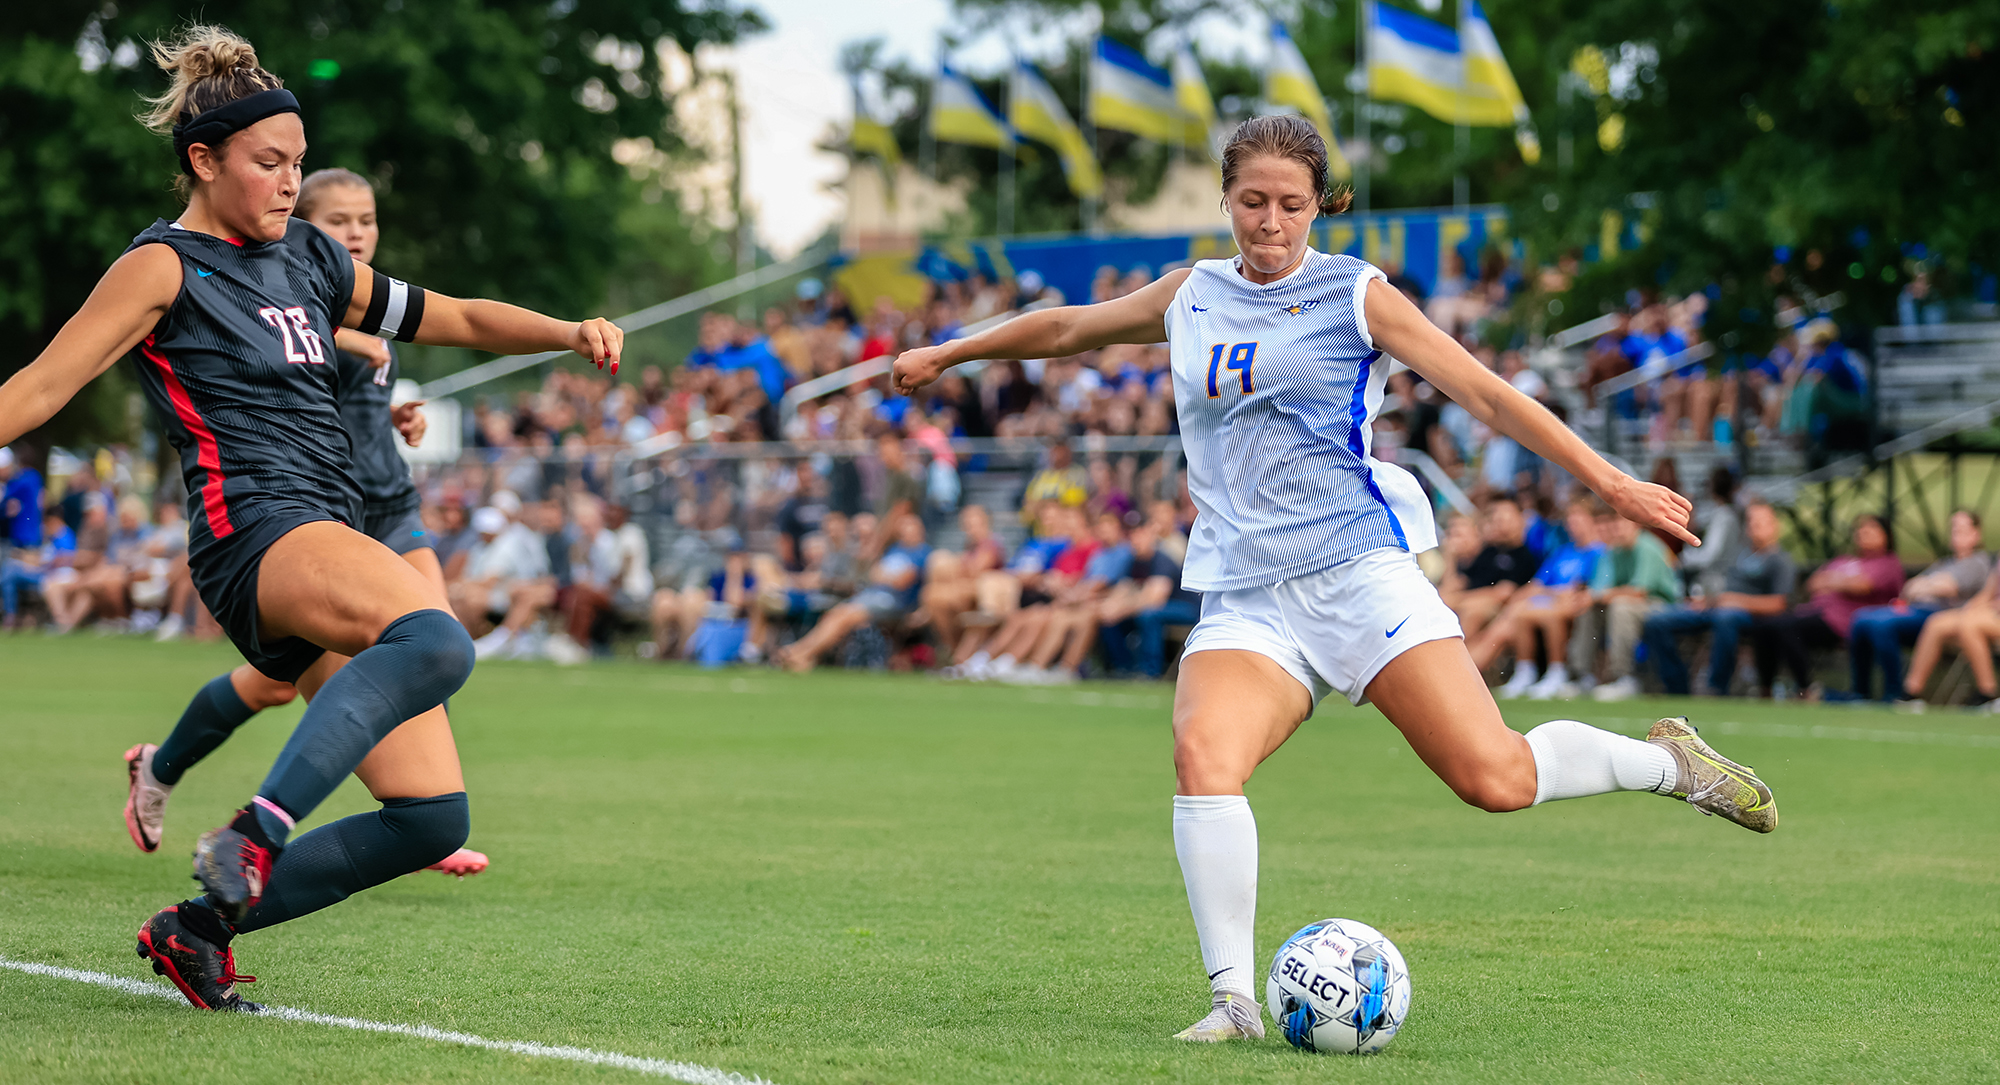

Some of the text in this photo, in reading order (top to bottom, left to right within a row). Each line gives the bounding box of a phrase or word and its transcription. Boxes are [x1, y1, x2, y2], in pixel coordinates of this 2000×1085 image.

[258, 306, 325, 364] 26
[1205, 340, 1260, 399] 19
[1320, 939, 1347, 959] NAIA
[1281, 956, 1350, 1009] SELECT
